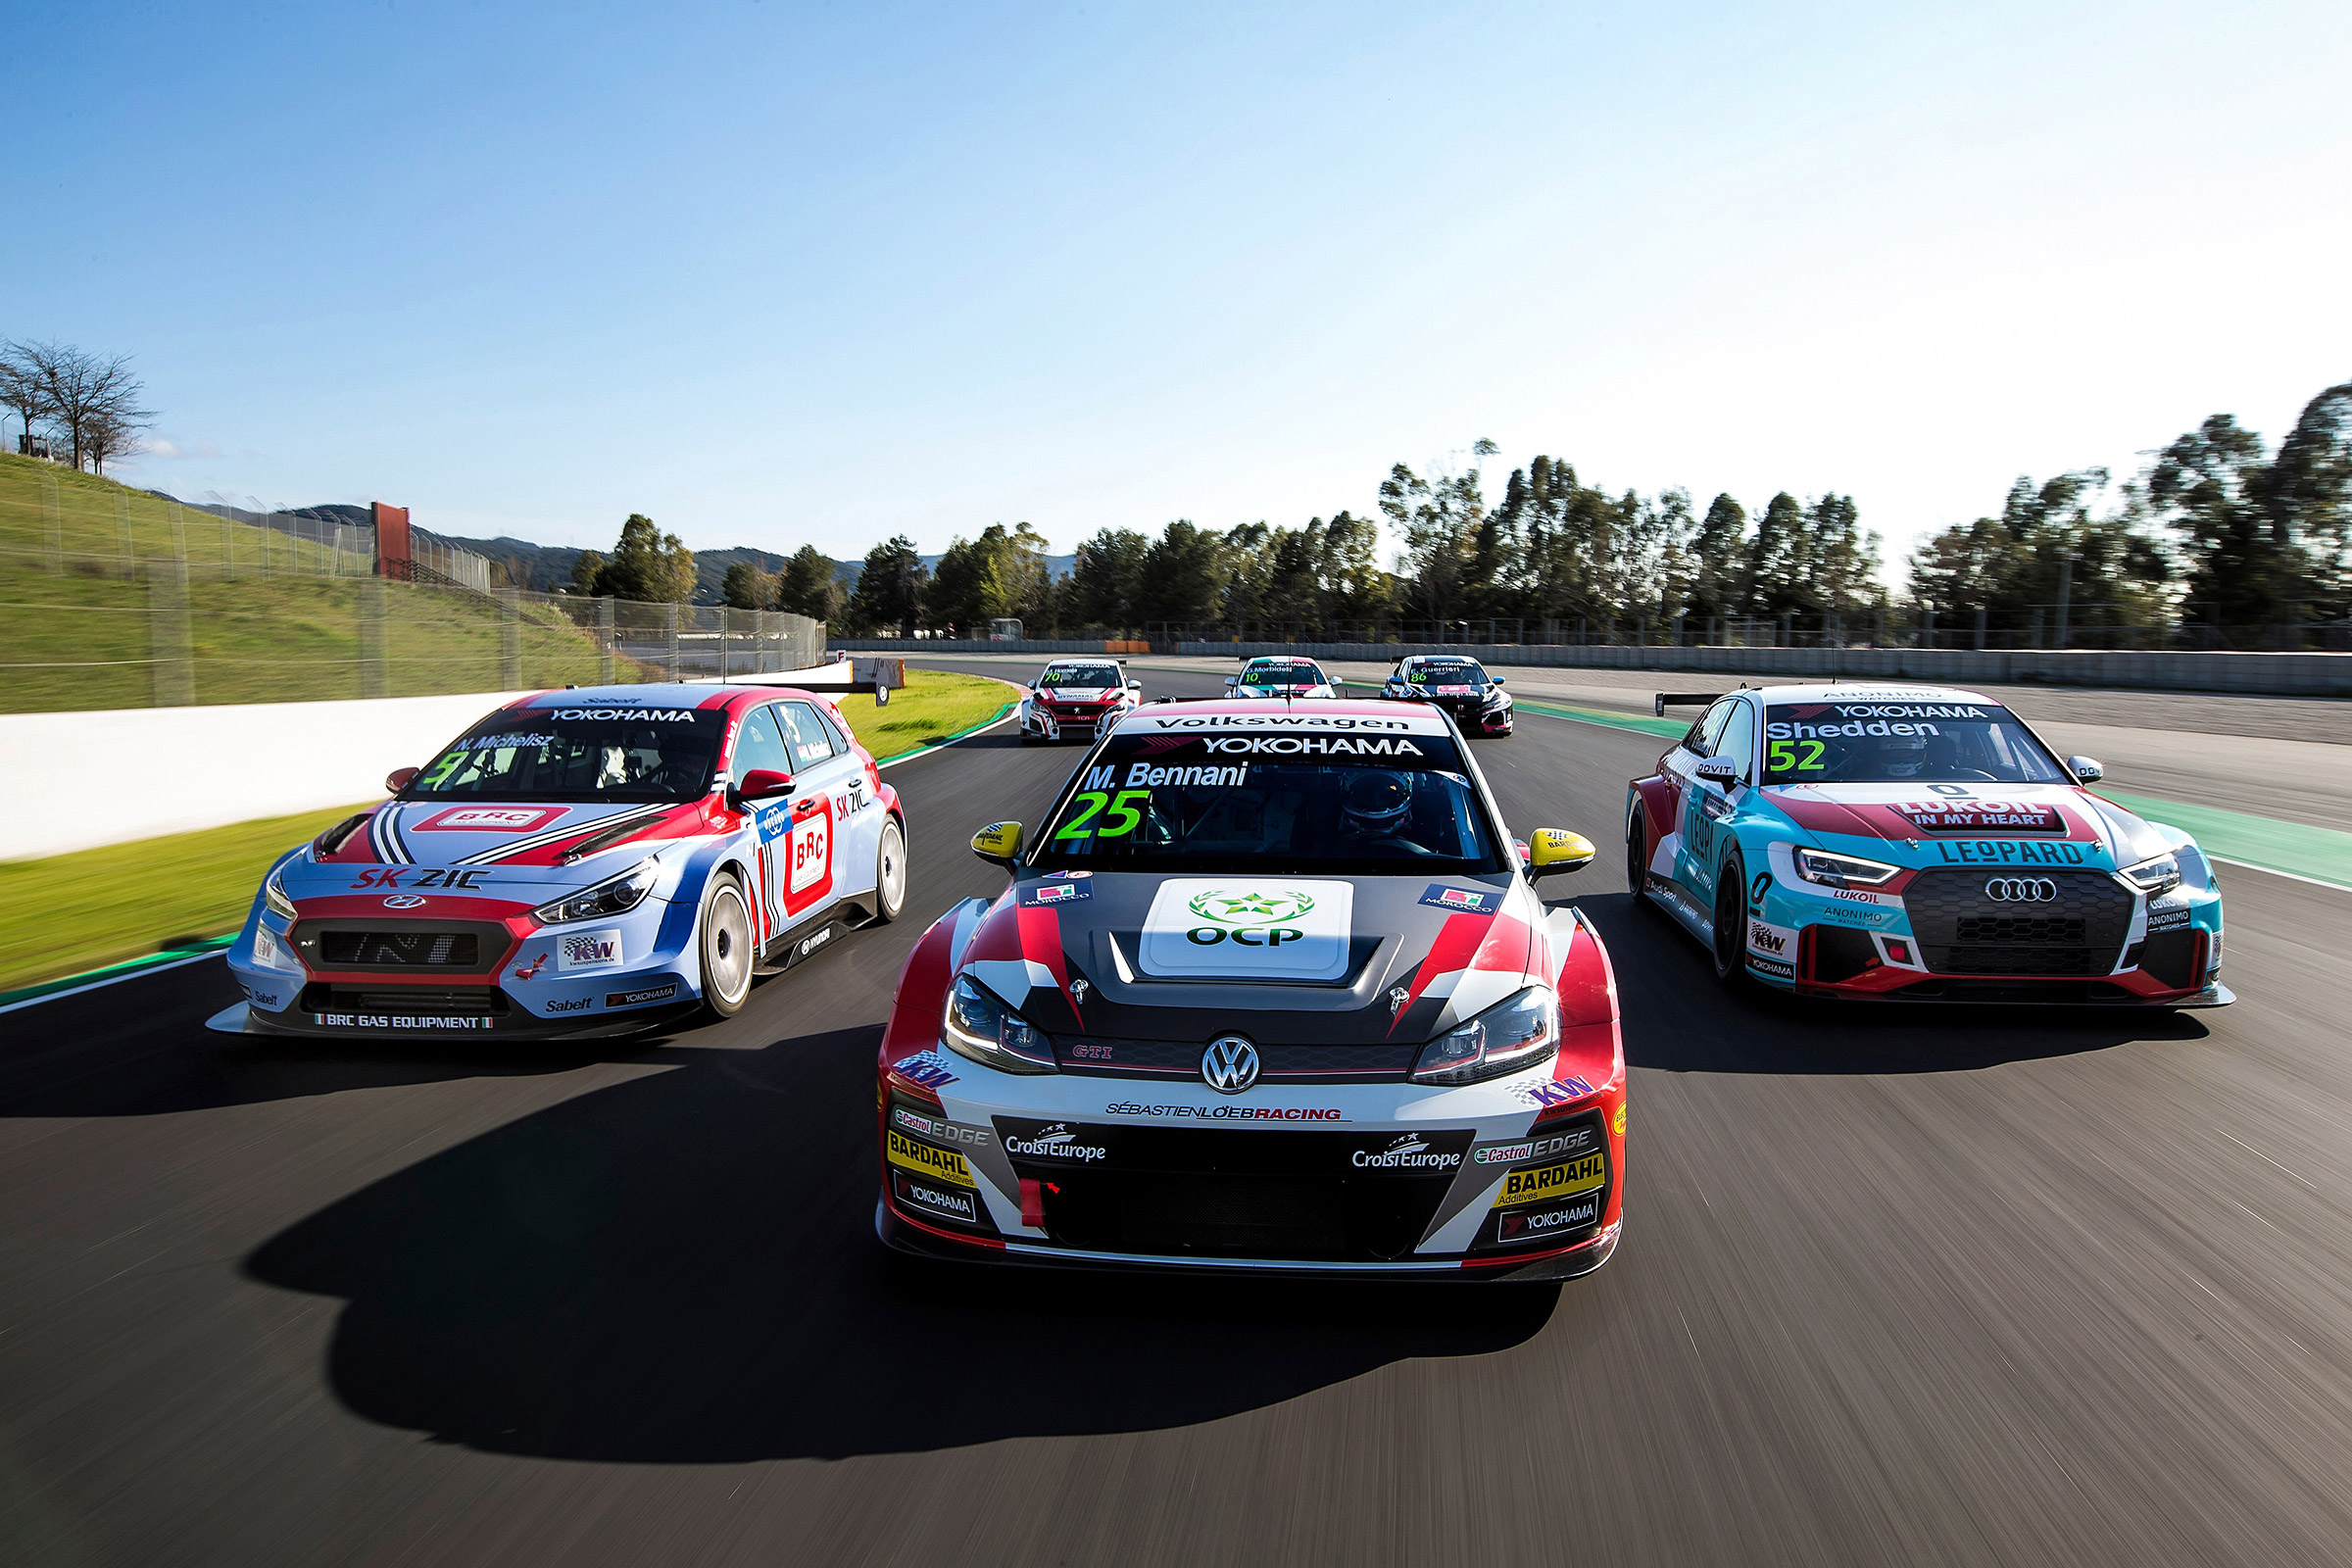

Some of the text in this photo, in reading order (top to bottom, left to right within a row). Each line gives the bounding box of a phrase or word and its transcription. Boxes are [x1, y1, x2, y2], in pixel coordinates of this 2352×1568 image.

[1045, 672, 1060, 682] 70
[1246, 673, 1258, 682] 10
[1411, 672, 1427, 682] 86
[550, 709, 696, 723] YOKOHAMA
[1835, 705, 1989, 718] YOKOHAMA
[1155, 715, 1410, 731] Volkswagen
[1766, 720, 1939, 739] Shedden
[472, 733, 555, 751] Michelisz
[1201, 737, 1424, 757] YOKOHAMA
[1769, 740, 1826, 771] 52
[1084, 760, 1250, 791] M. Bennani
[455, 811, 530, 821] BRC
[1055, 789, 1152, 841] 25
[1897, 801, 2049, 815] LUKOIL
[1915, 813, 2045, 825] IN MY HEART
[797, 831, 823, 870] BRC
[1937, 840, 2083, 866] LEOPARD
[349, 868, 495, 892] SK ZIC
[1025, 892, 1090, 906] MOROCCO
[1425, 897, 1493, 913] MOROCCO
[1834, 890, 1880, 905] LUKOIL
[1824, 906, 1883, 922] ANONIMO
[2148, 910, 2189, 926] ANONIMO
[1186, 927, 1303, 947] OCP
[573, 941, 615, 961] KW
[1752, 957, 1792, 976] YOKOHAMA
[256, 990, 277, 1007] Sabelt
[625, 987, 673, 1004] YOKOHAMA
[545, 997, 594, 1013] Sabelt
[326, 1015, 478, 1029] BRC GAS EQUIPMENT
[1073, 1045, 1113, 1059] GTI
[896, 1060, 960, 1089] KW
[1529, 1076, 1594, 1106] KW
[902, 1111, 991, 1147] Castrol EDGE
[1005, 1135, 1105, 1162] CroisiEurope
[1489, 1129, 1592, 1162] Castrol EDGE
[890, 1134, 970, 1176] BARDAHL
[1351, 1150, 1460, 1170] CroisiEurope
[941, 1169, 975, 1187] Additives
[1507, 1156, 1603, 1194] BARDAHL
[909, 1184, 971, 1214] YOKOHAMA
[1498, 1191, 1539, 1205] Additives
[1527, 1203, 1593, 1231] YOKOHAMA
